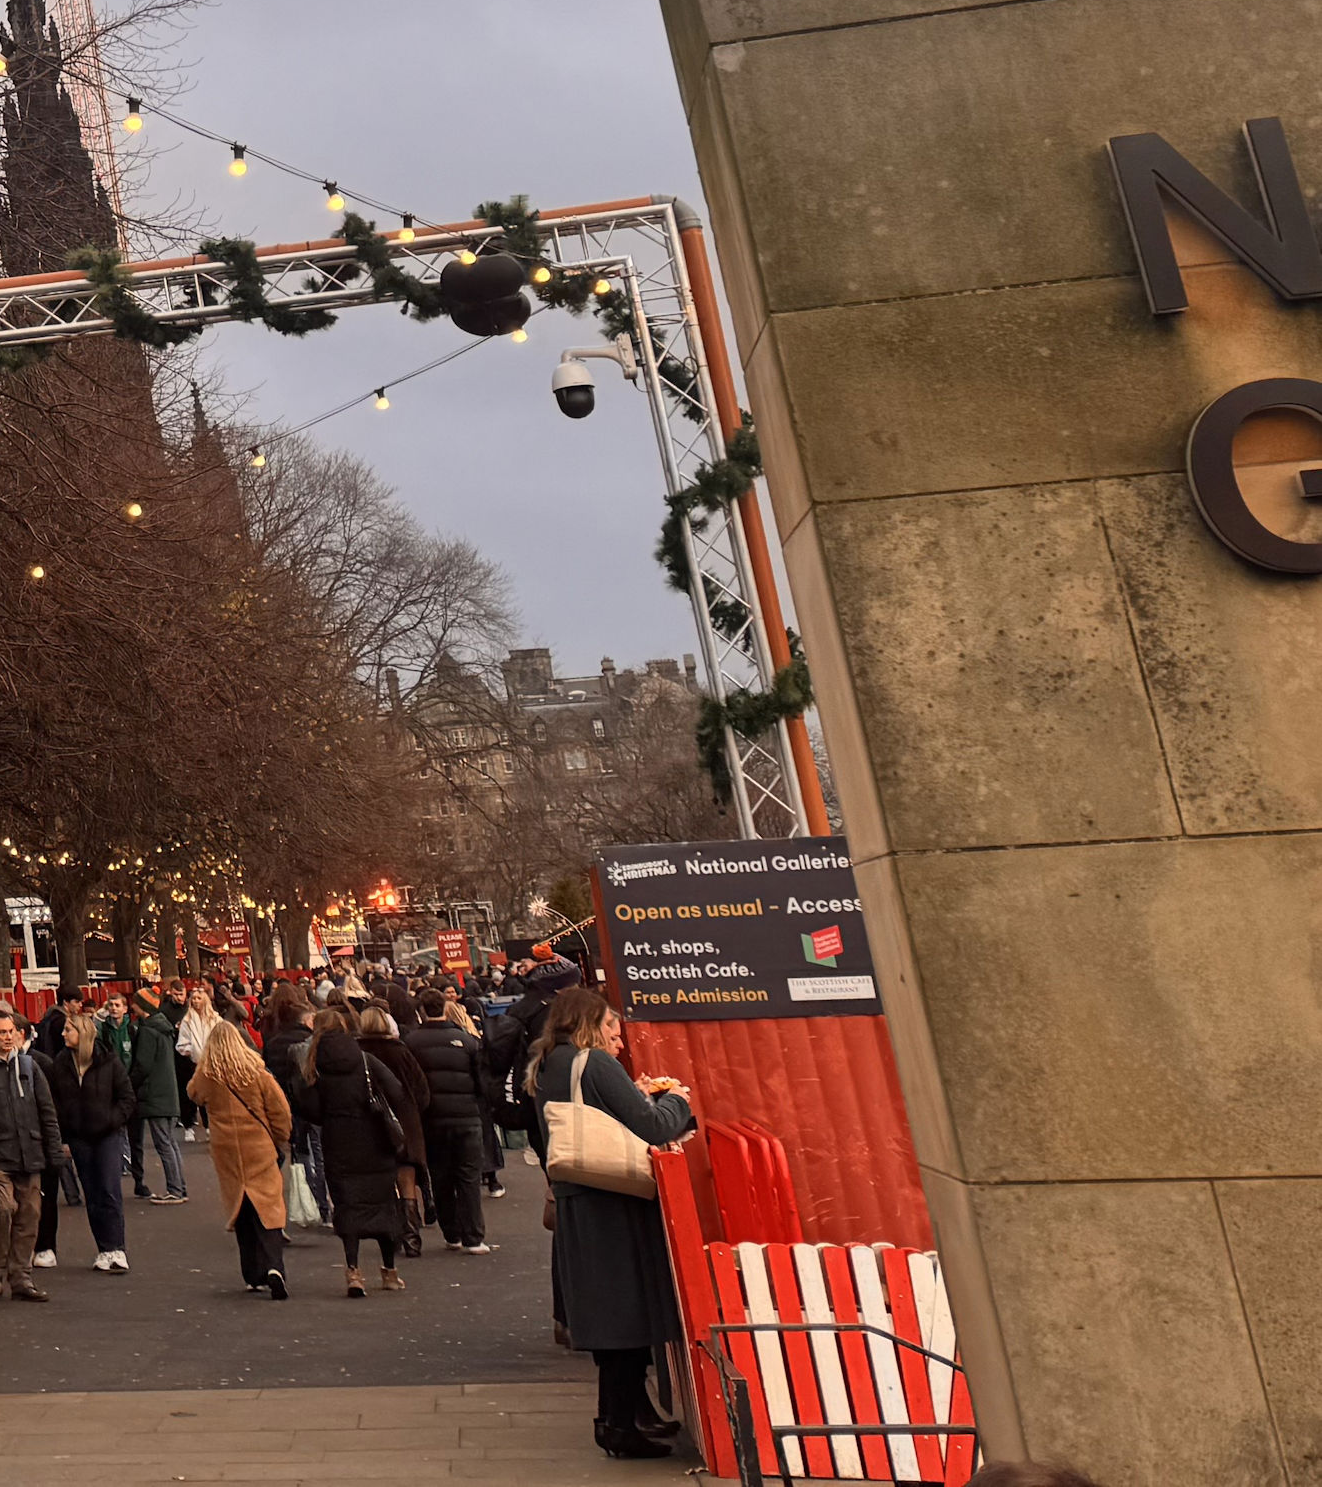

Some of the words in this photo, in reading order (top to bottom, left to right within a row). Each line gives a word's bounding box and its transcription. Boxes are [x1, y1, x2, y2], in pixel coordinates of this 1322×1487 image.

[613, 864, 677, 881] CHRISTMAS
[685, 856, 767, 876] National
[614, 902, 673, 924] Open
[676, 904, 702, 919] as
[706, 899, 764, 917] usual
[438, 933, 464, 942] PLEASE
[444, 942, 462, 950] KEEP
[446, 950, 463, 958] LEFT
[623, 941, 658, 957] Art,
[661, 939, 721, 957] shops,
[626, 963, 703, 981] Scottish
[705, 962, 756, 979] Cafe.
[630, 989, 672, 1006] Free
[675, 987, 769, 1004] Admission
